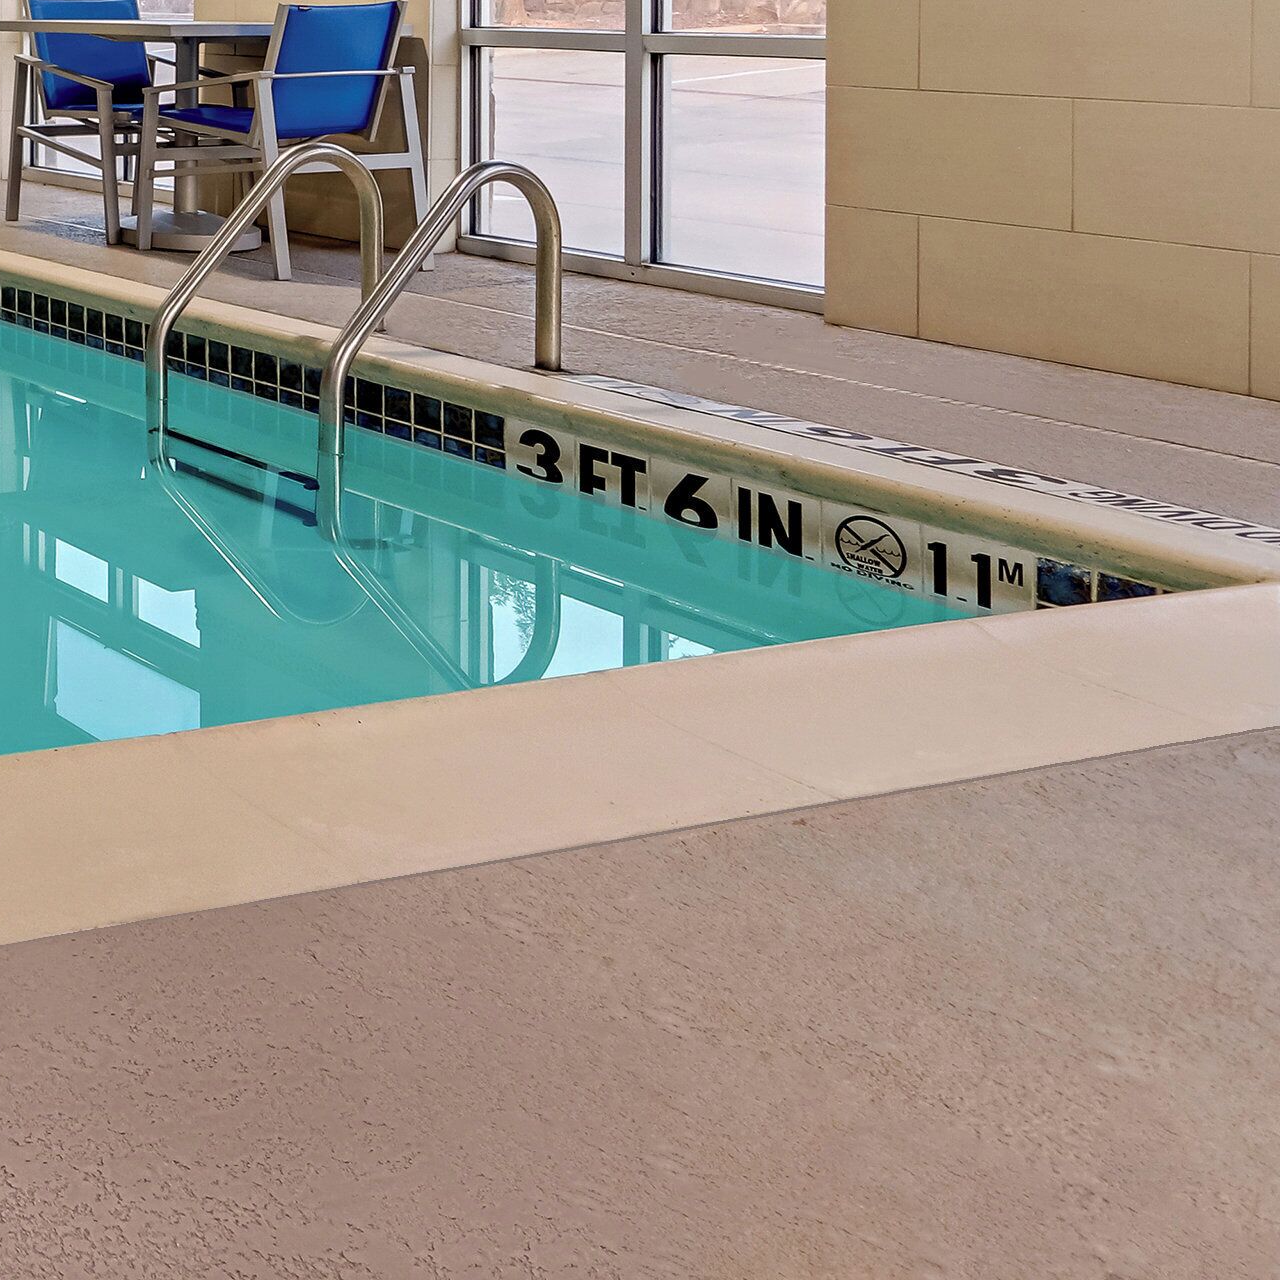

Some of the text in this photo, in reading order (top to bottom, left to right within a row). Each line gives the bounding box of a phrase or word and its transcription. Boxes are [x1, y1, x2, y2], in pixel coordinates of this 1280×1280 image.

[795, 426, 874, 440] 6
[516, 428, 564, 483] 3
[663, 473, 719, 530] 6
[973, 468, 1068, 485] 3
[1069, 491, 1257, 529] DIVING
[846, 552, 881, 567] SHALLOW
[831, 562, 914, 590] NO DIVING
[857, 563, 883, 574] WATER
